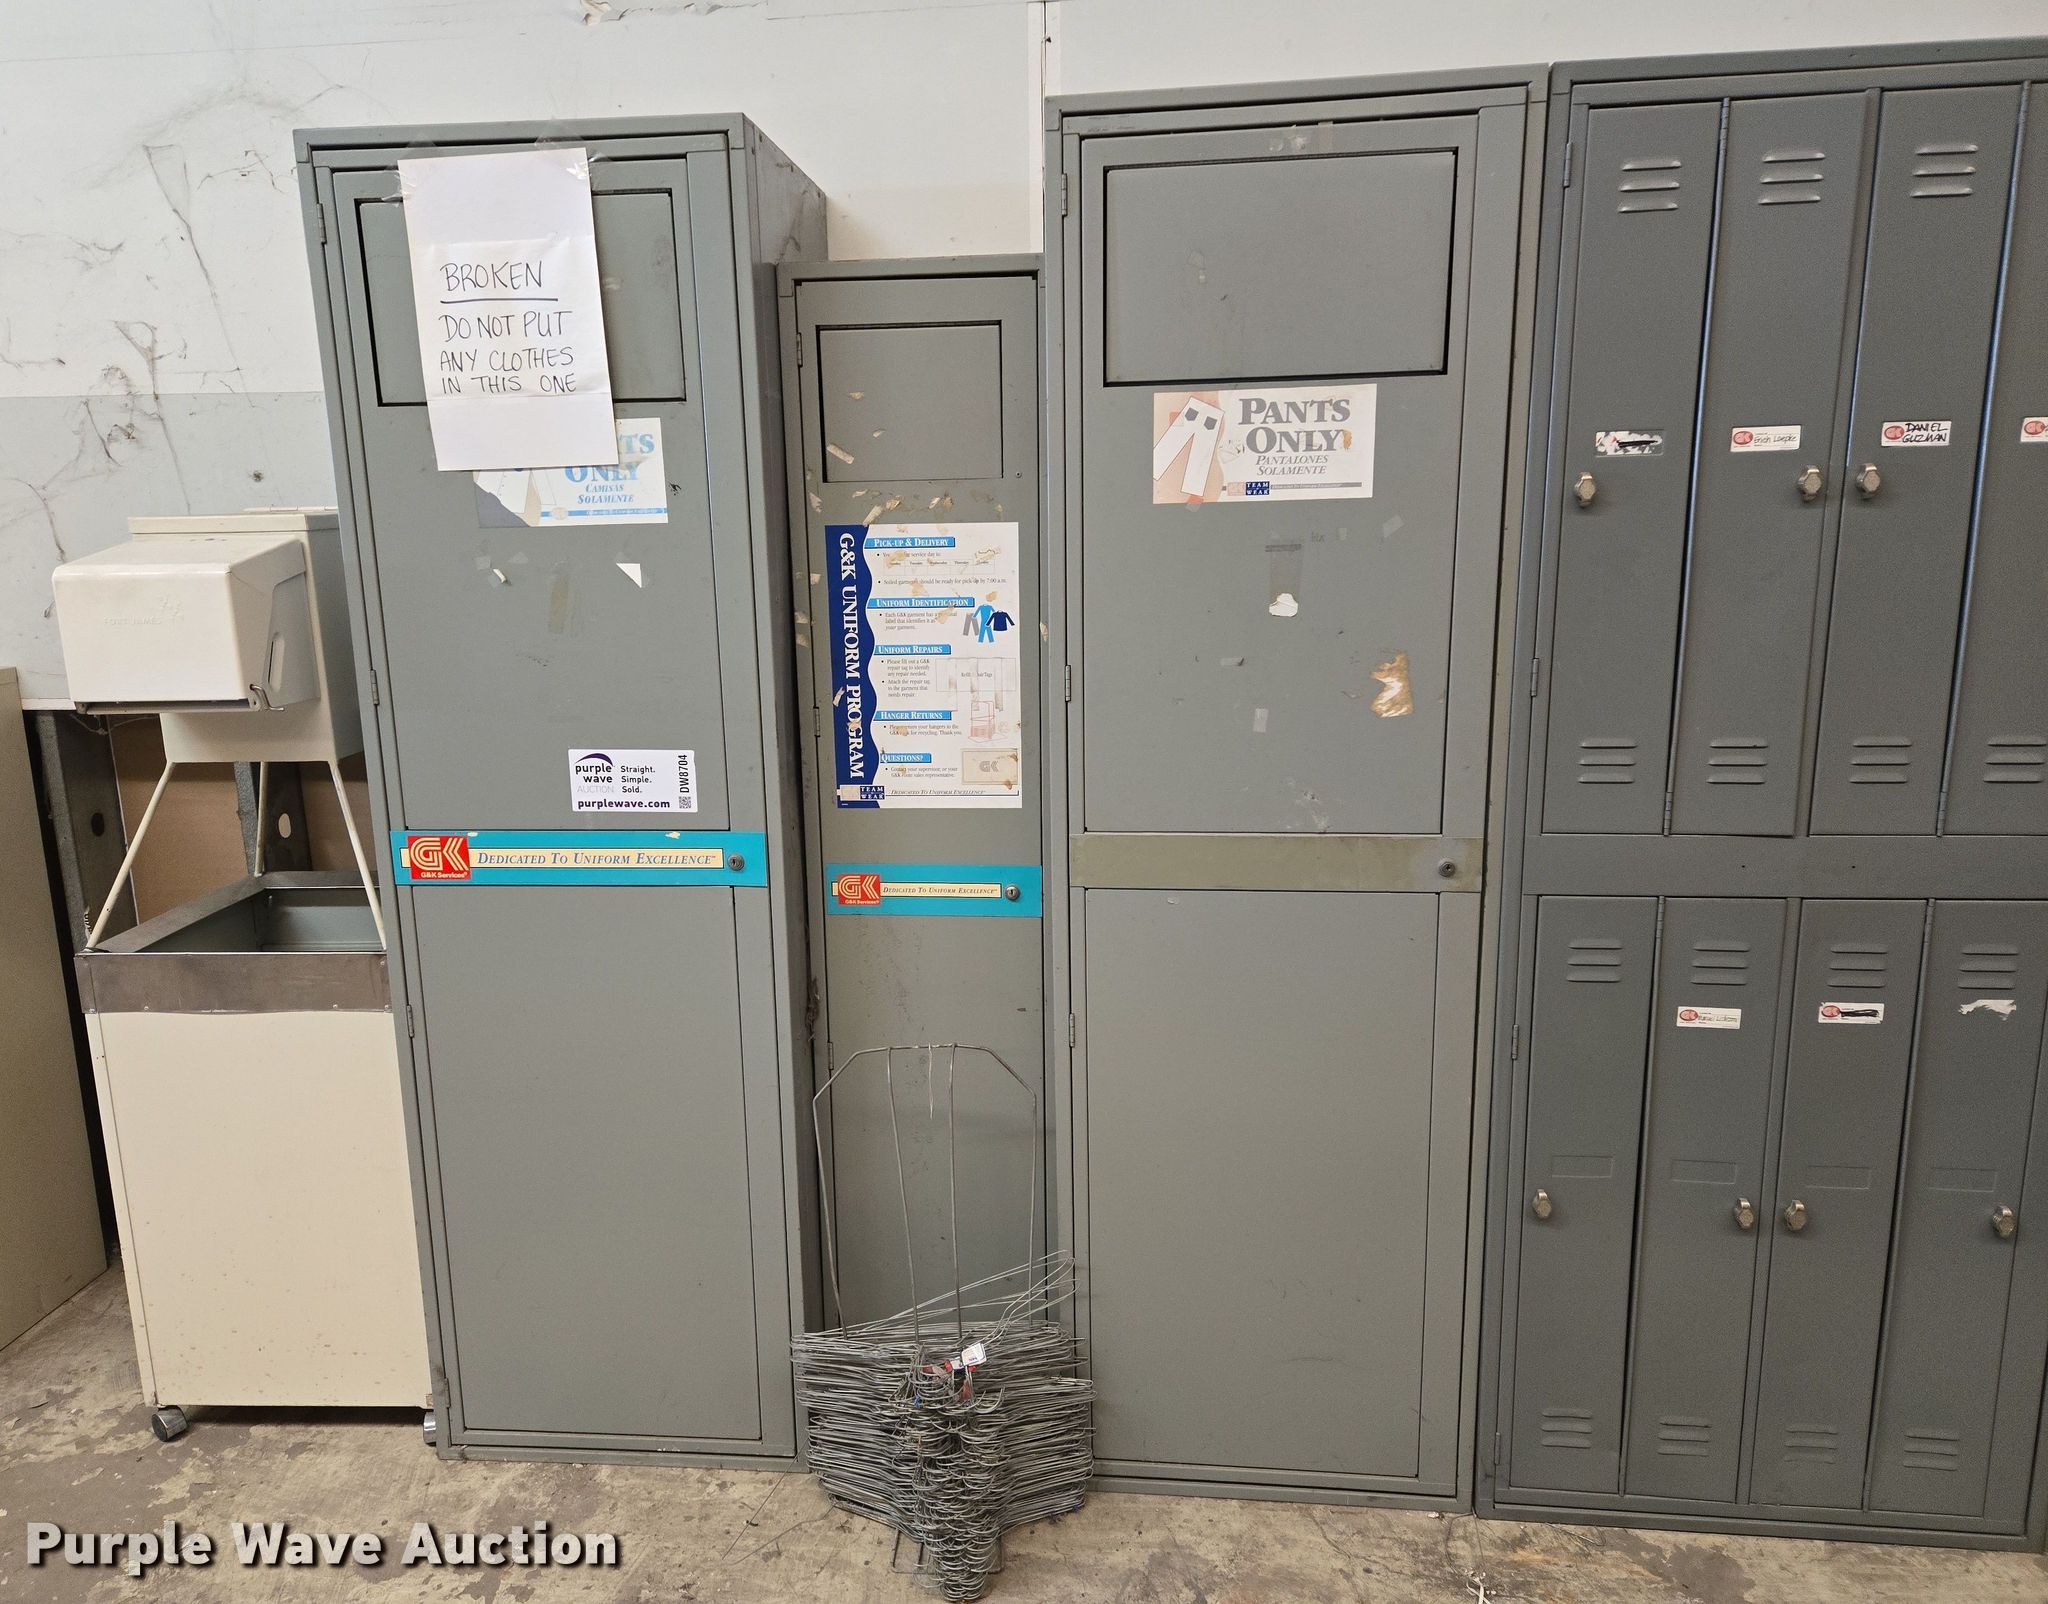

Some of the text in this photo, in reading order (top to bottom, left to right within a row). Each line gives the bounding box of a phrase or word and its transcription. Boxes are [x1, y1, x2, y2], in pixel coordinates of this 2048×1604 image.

[440, 261, 543, 292] BROKEN
[440, 310, 573, 342] DO NOT PUT
[440, 346, 574, 372] ANY CLOTHES
[442, 373, 577, 394] IN THIS ONE
[1238, 398, 1350, 425] PANTS
[1905, 423, 1948, 432] DANIEL
[1246, 427, 1345, 454] ONLY
[1902, 433, 1947, 443] GUZMAN
[1255, 454, 1329, 466] PANTALONES
[1257, 465, 1327, 476] SOLAMENTE
[585, 484, 624, 493] CAMISAS
[578, 495, 634, 505] SOLAMENTE
[874, 538, 949, 547] PICK-UP & DELIVERY
[876, 598, 969, 607] UNIFORM IDENTIFICATION
[878, 645, 943, 654] UNIFORM REPAIRS
[839, 533, 865, 778] G&K UNIFORM PROGRAM
[880, 711, 943, 720] HANGER RETURNS
[881, 754, 923, 763] QUESTIONS?
[575, 763, 612, 775] purple
[620, 766, 656, 775] Straight.
[678, 754, 690, 793] DW8704
[583, 775, 613, 783] wave
[621, 775, 652, 783] Simple.
[622, 785, 642, 793] Sold.
[578, 798, 671, 810] purplewave.com
[478, 852, 712, 865] DEDICATED TO UNIFORM EXCELLENCE
[883, 886, 916, 894] DEDICATED
[918, 886, 926, 894] TO
